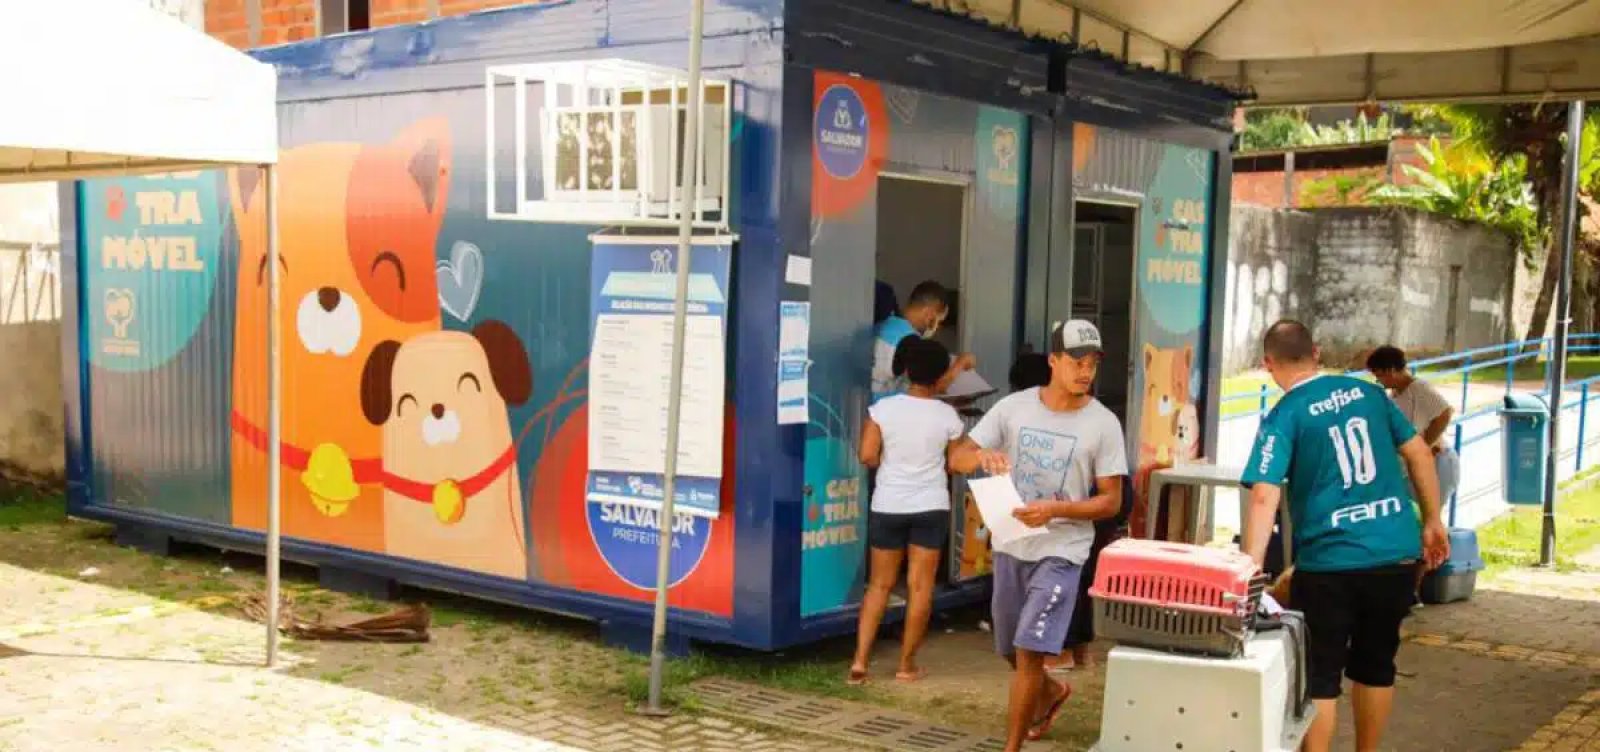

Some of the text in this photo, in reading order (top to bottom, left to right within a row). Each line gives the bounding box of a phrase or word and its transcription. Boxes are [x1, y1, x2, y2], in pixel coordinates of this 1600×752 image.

[135, 190, 203, 225] TRA
[1172, 199, 1205, 223] CAS
[102, 229, 205, 271] MÓVEL
[1169, 231, 1203, 253] TRA
[1147, 254, 1202, 284] MÓVEL
[1308, 386, 1365, 416] crefisa
[1259, 434, 1276, 475] crefisa
[1328, 416, 1377, 489] 10
[824, 501, 860, 522] TRA
[612, 527, 681, 549] PREFEITA
